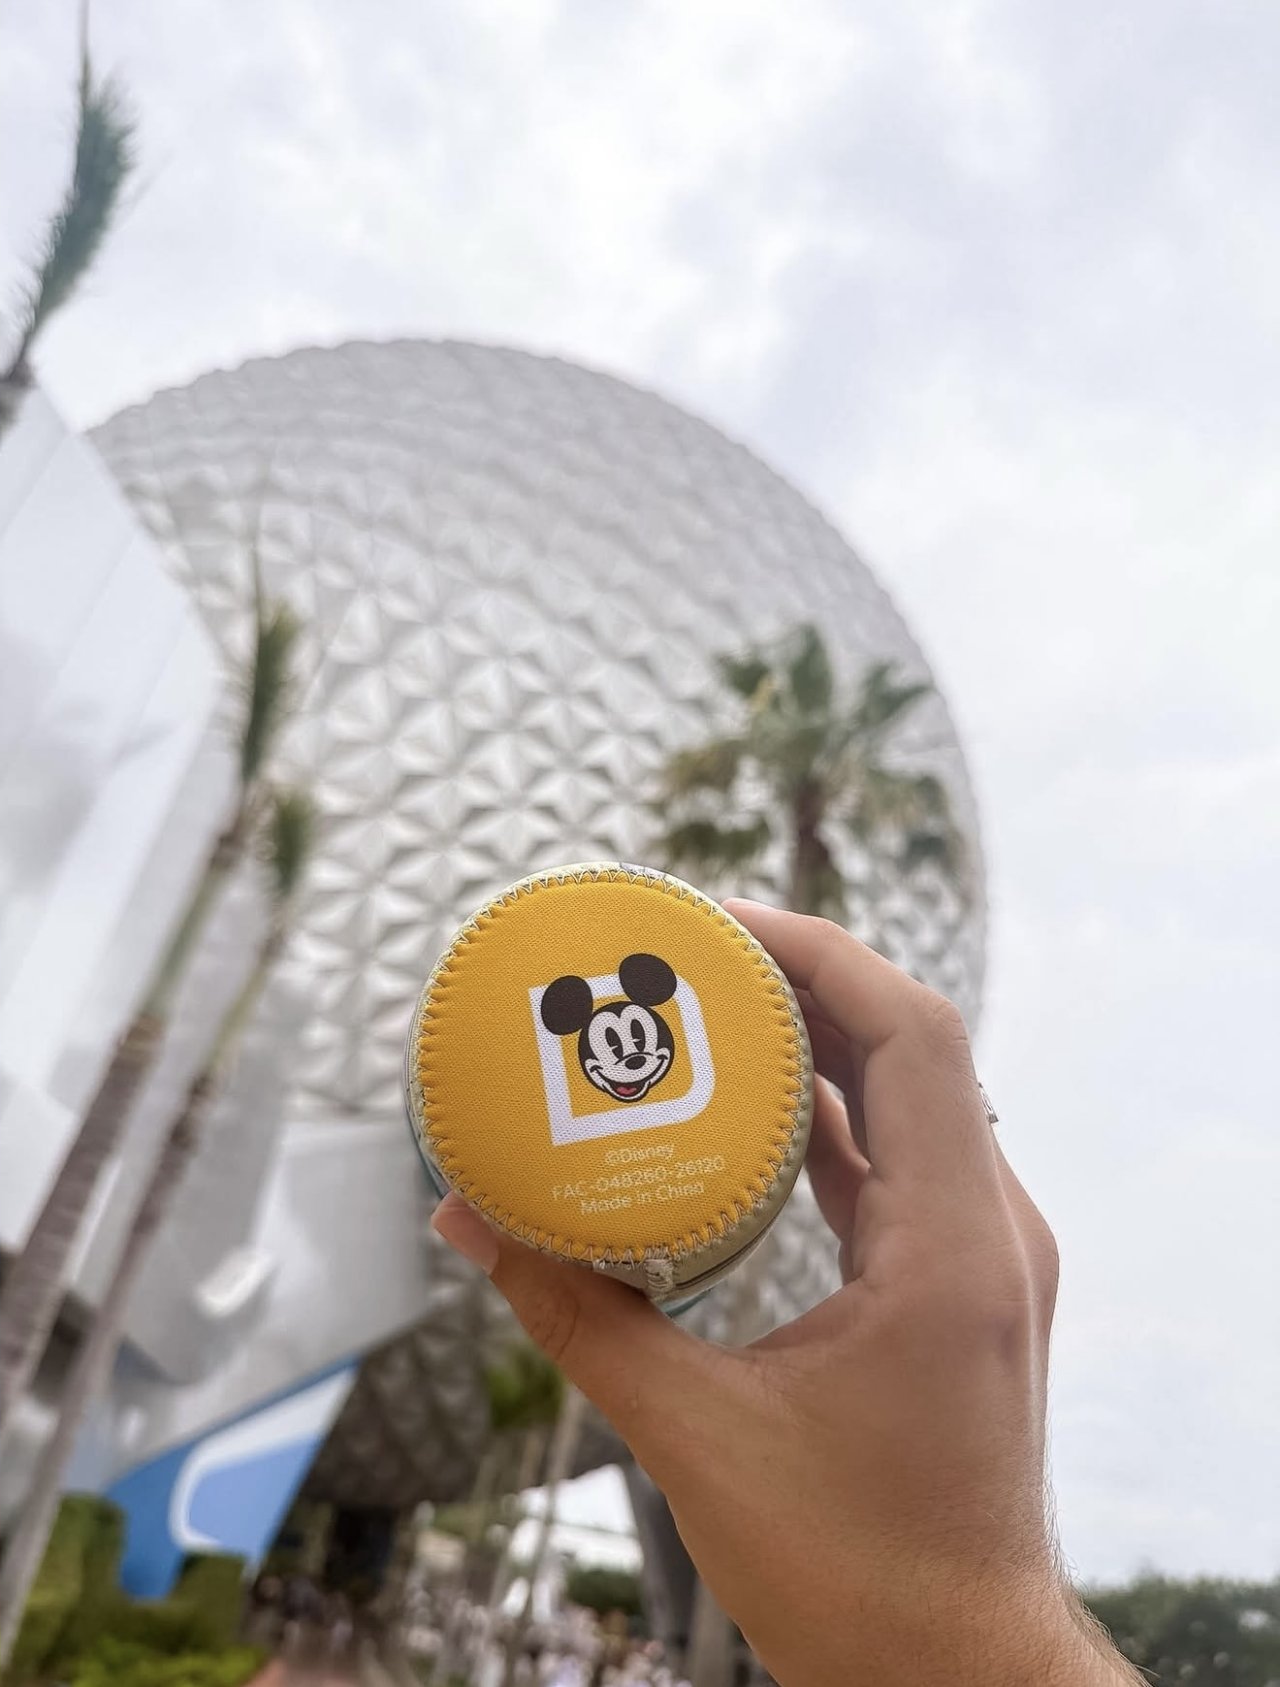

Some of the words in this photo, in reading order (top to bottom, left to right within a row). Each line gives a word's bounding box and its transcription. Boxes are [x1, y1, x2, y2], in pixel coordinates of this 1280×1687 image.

[580, 1196, 631, 1215] Made
[637, 1191, 652, 1203] in
[657, 1181, 705, 1201] China
